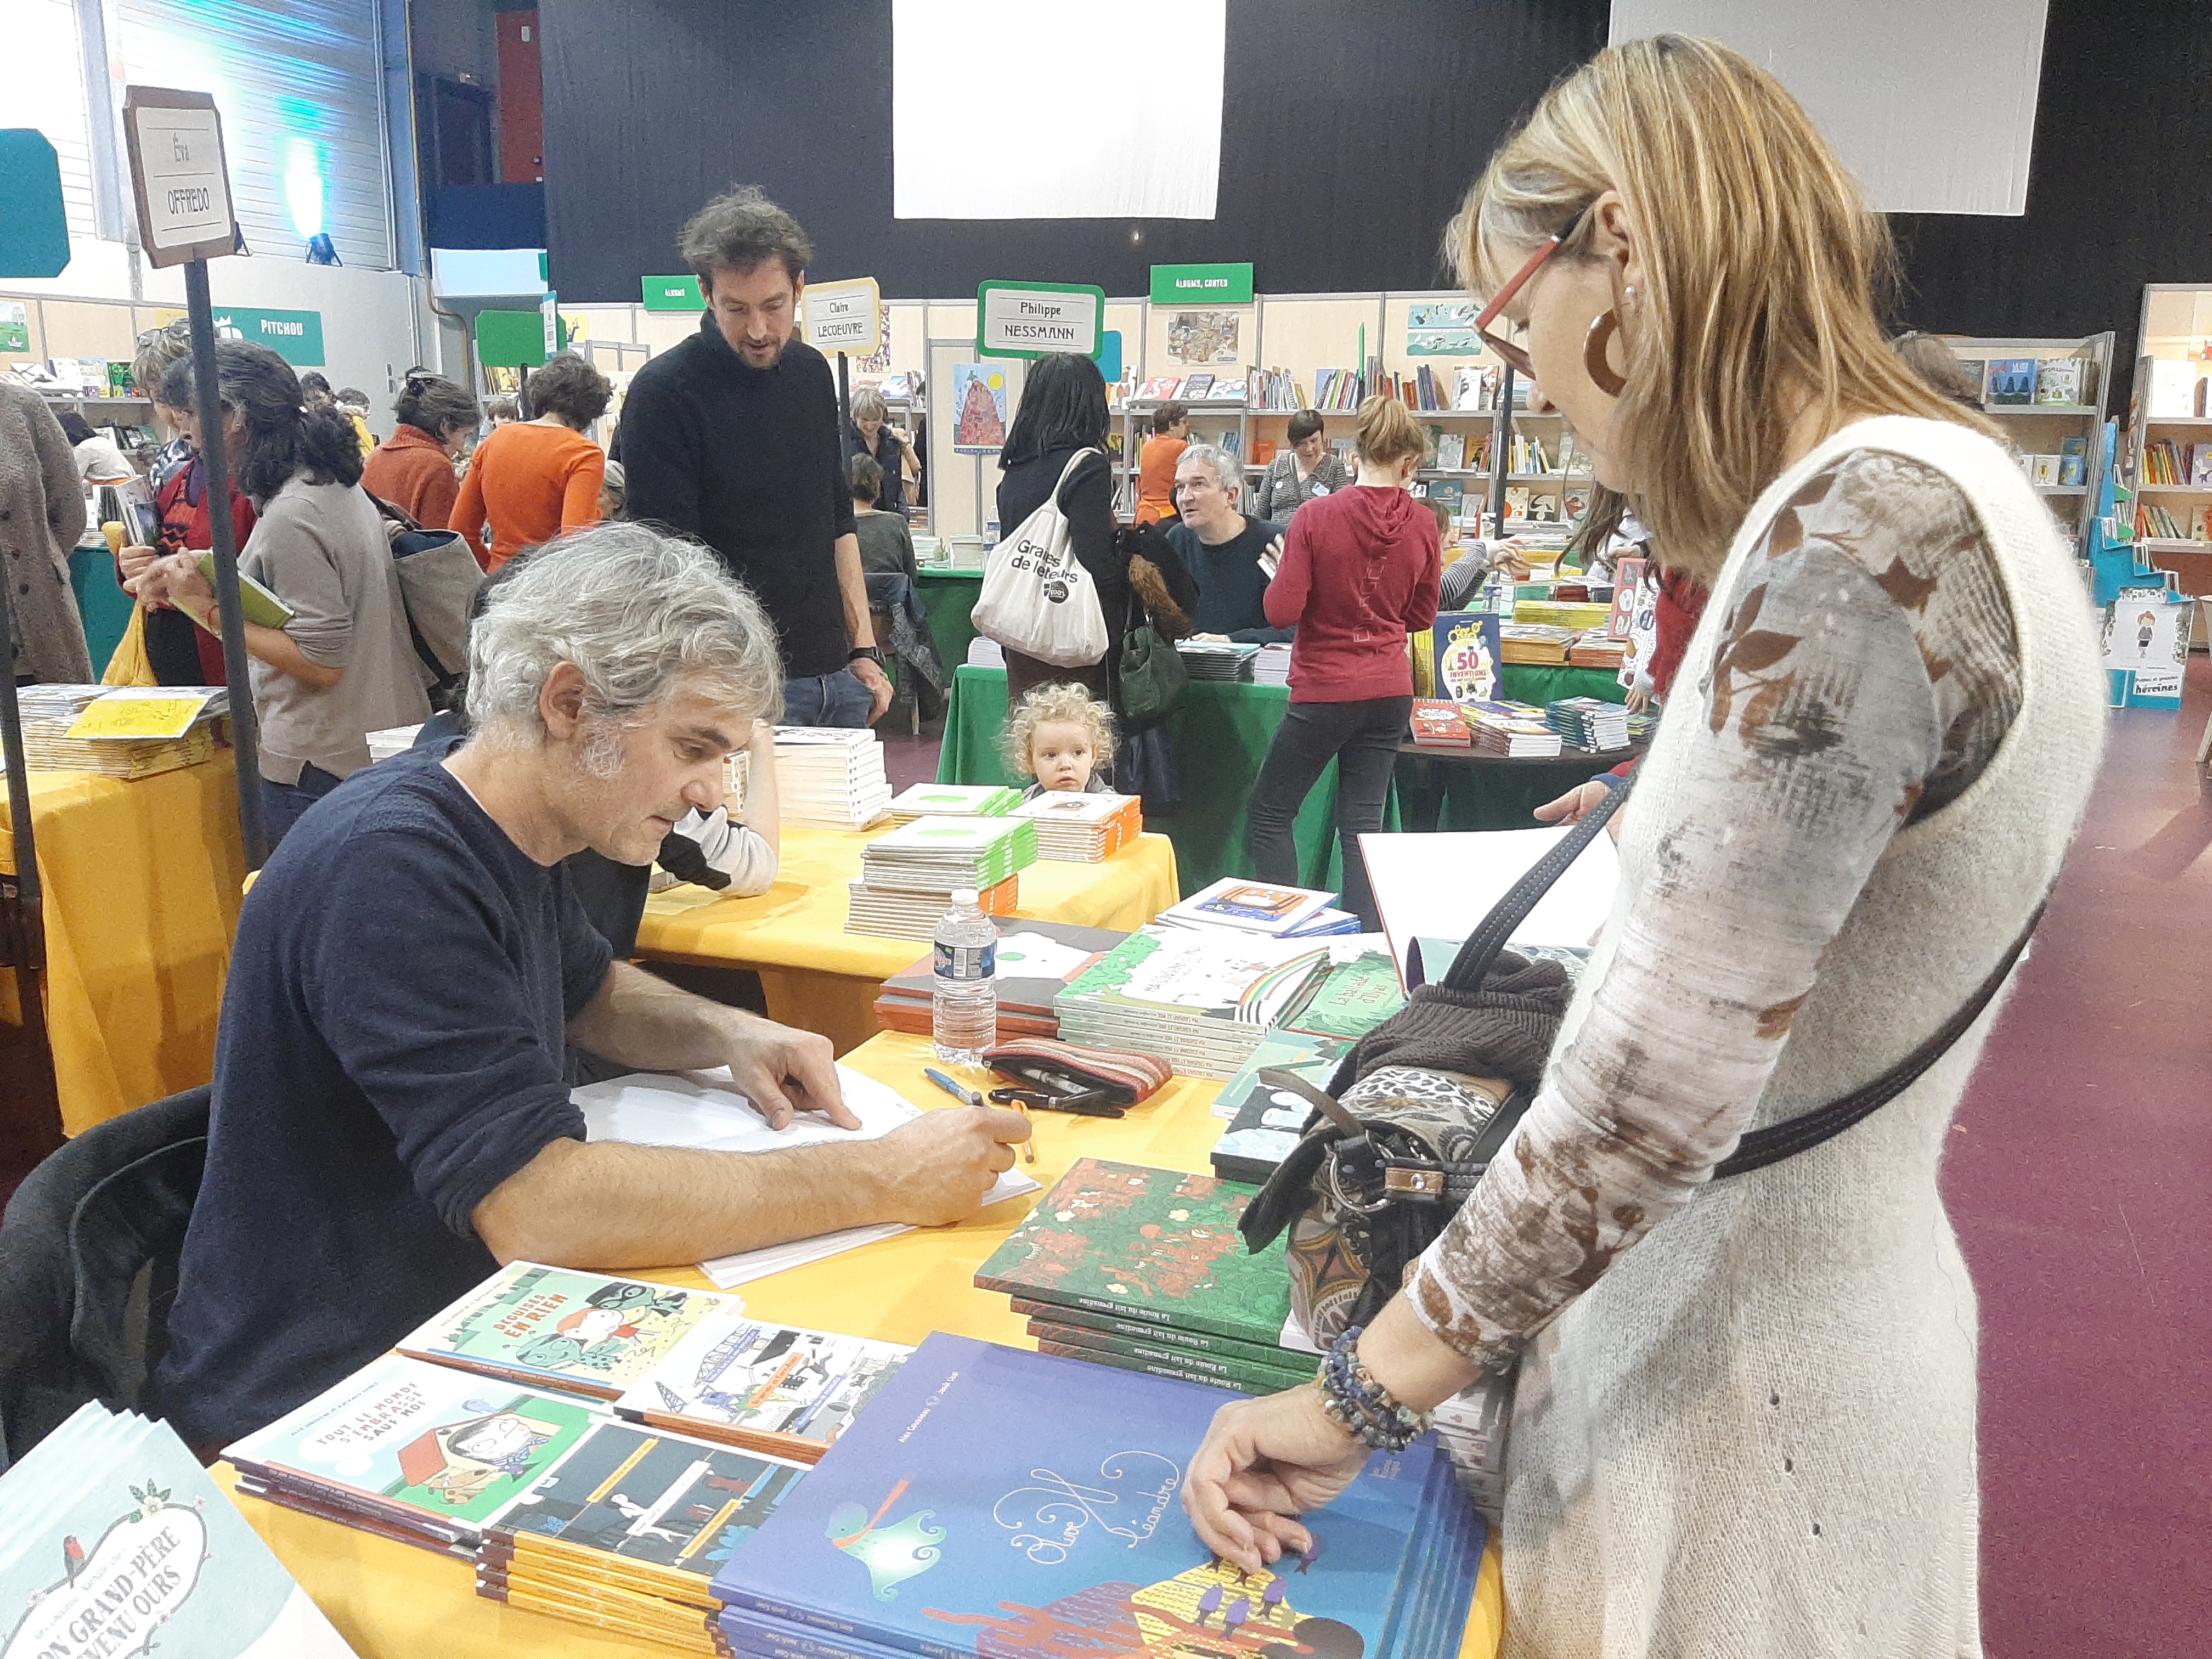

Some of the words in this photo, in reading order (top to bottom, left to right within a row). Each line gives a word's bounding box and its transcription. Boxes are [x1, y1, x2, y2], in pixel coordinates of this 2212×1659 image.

[168, 187, 210, 215] OFFREDO
[830, 302, 849, 313] Claire
[1020, 302, 1062, 318] Philippe
[261, 319, 303, 336] PITCHOU
[817, 323, 863, 337] LECOEUVRE
[1005, 324, 1074, 339] NESSMANN
[1018, 539, 1061, 567] Graies
[1011, 555, 1030, 570] de
[1033, 560, 1078, 583] leteurs
[1457, 652, 1479, 670] 50
[504, 1321, 532, 1339] EN
[524, 1294, 569, 1321] RIEN
[316, 1424, 351, 1444] TOUT
[355, 1412, 373, 1423] LE
[374, 1382, 417, 1410] MONDE
[340, 1391, 423, 1443] S'EMBRASSE
[364, 1419, 398, 1441] SAUF
[400, 1400, 426, 1417] MOI
[69, 1526, 180, 1643] GRAND-PÈRE
[133, 1565, 180, 1615] OURS
